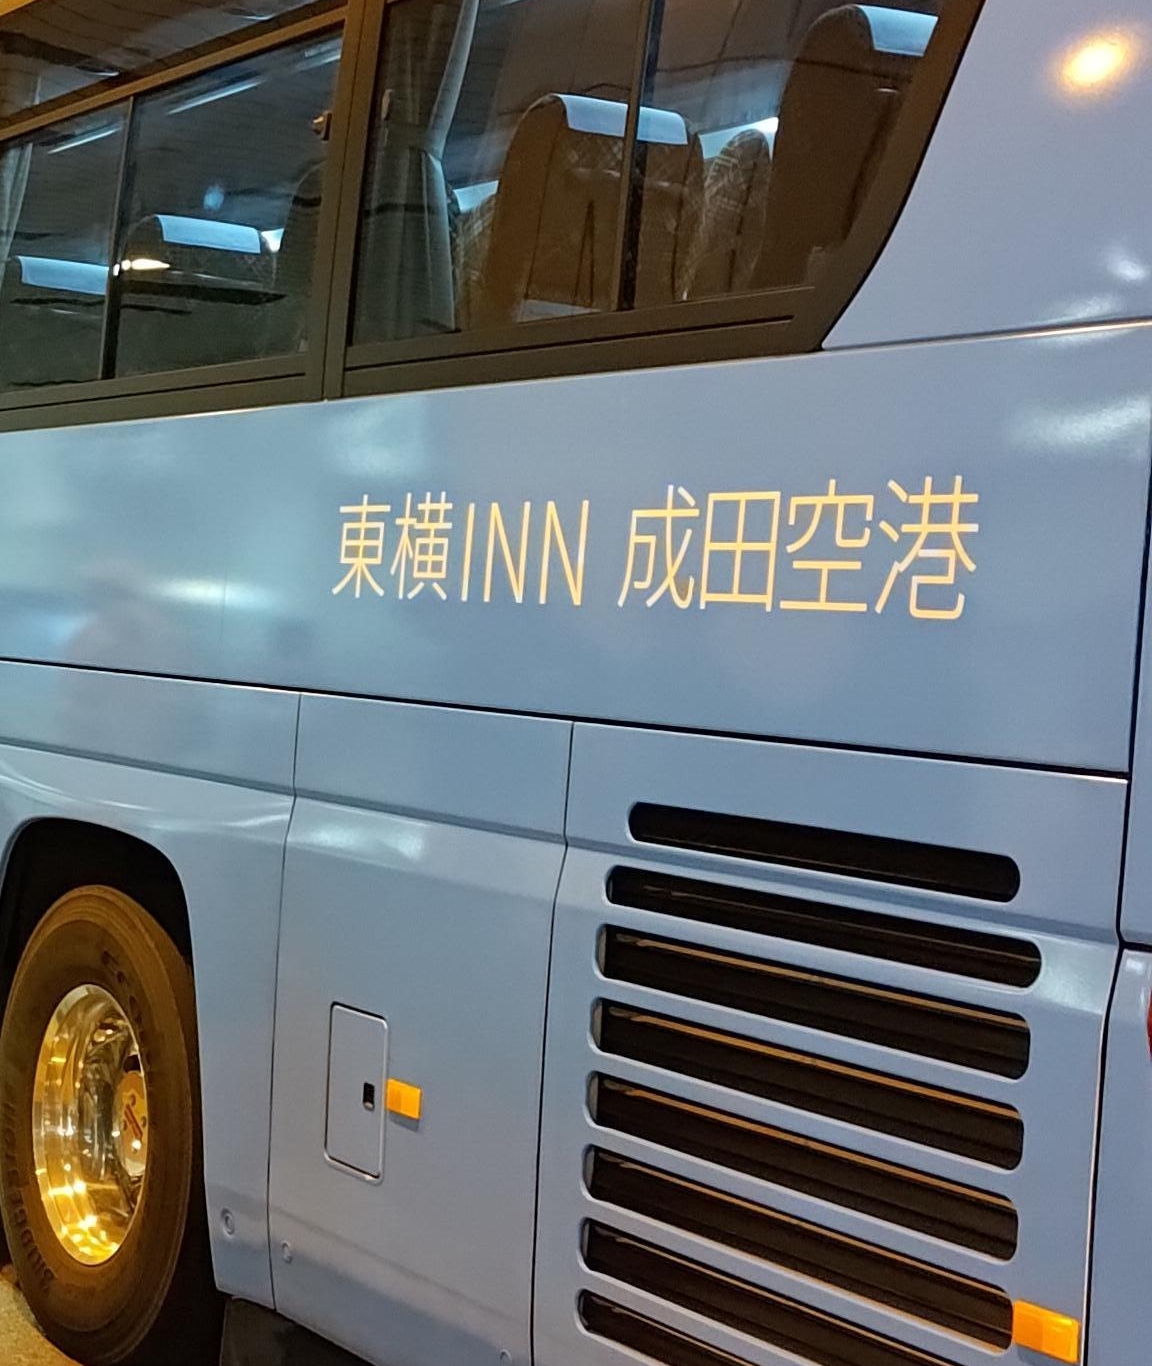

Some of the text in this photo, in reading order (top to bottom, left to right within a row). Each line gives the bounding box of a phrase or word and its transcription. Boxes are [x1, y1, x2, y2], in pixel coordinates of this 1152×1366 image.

[331, 474, 980, 620] 東横INN 成田空港
